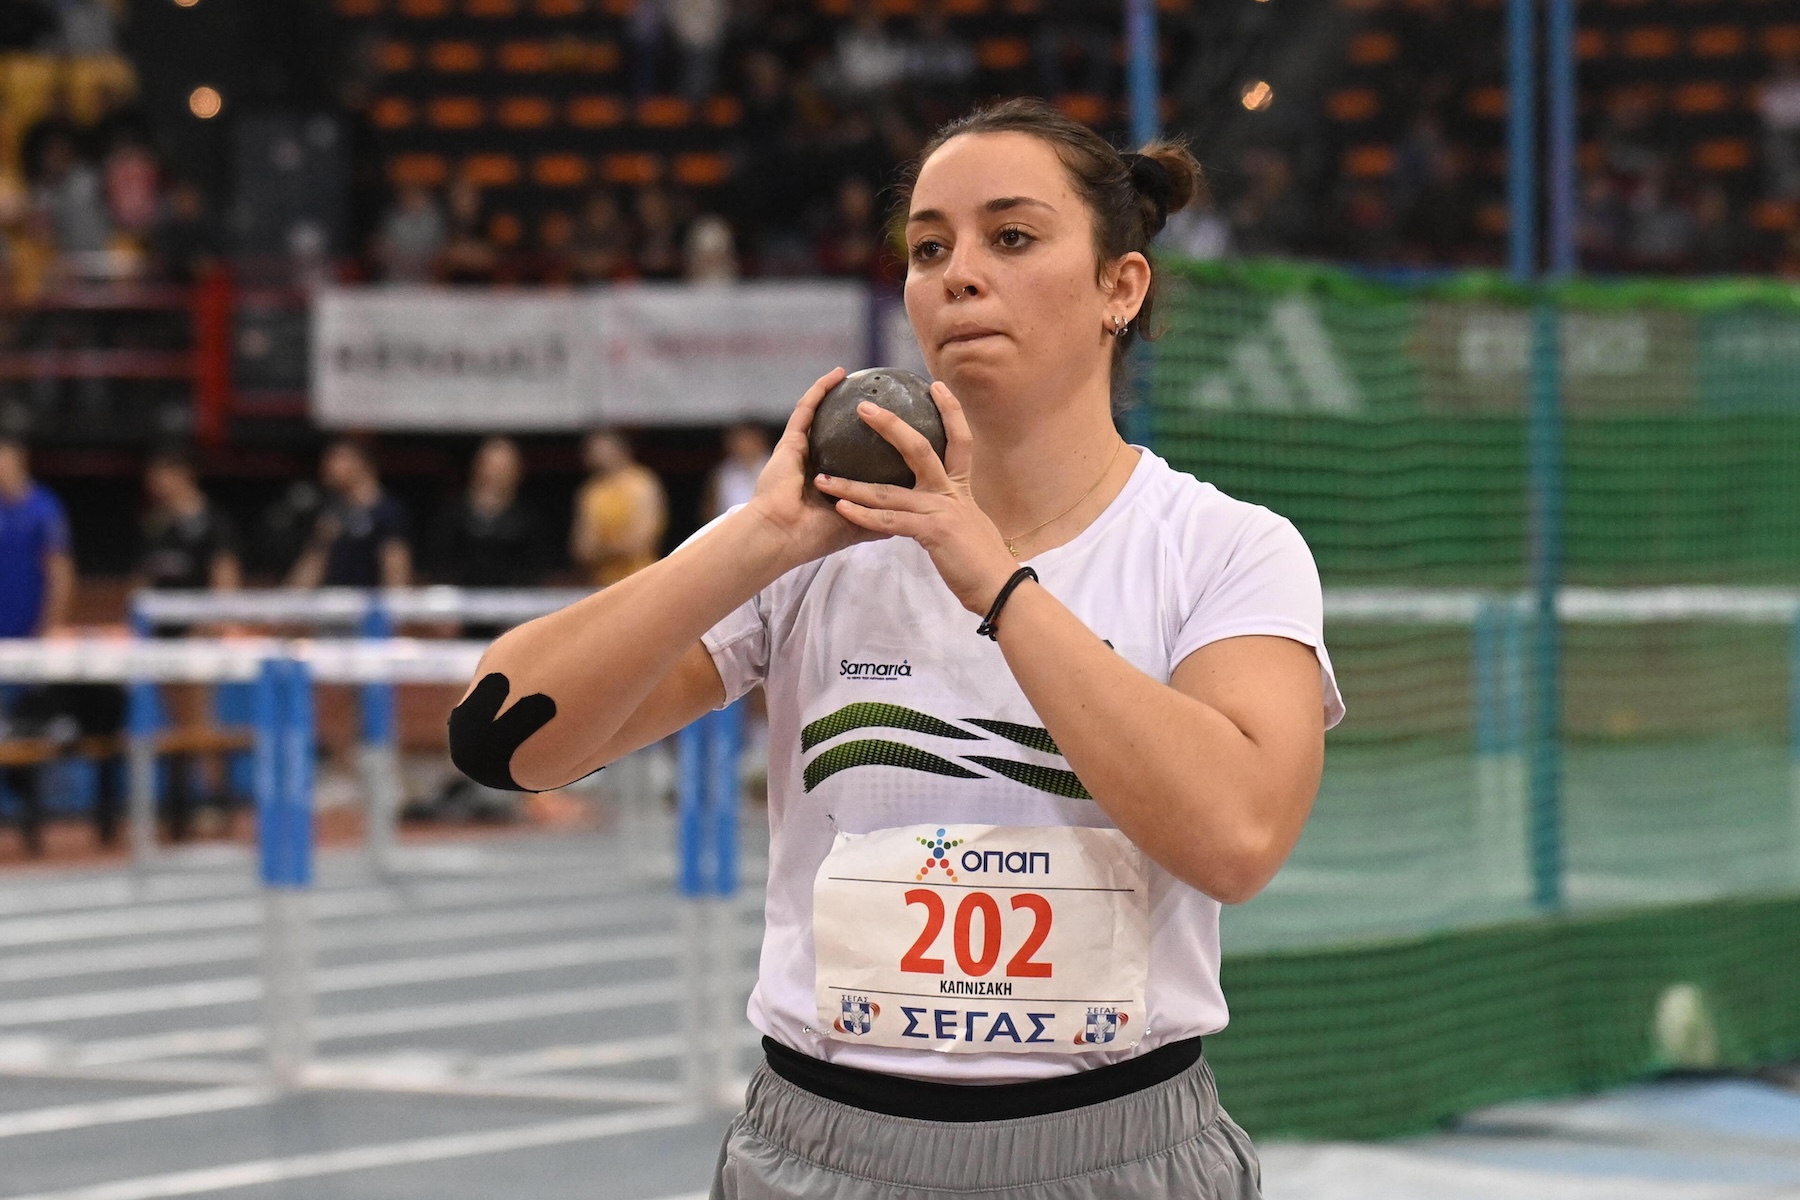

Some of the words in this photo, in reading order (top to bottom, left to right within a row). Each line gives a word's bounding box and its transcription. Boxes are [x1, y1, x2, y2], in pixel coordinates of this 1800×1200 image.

[900, 888, 1053, 978] 202
[940, 980, 1012, 996] ΚΑΠΝΙΣΑΚΗ
[841, 994, 869, 1003] ΣΕΓΑΣ
[1087, 1006, 1118, 1014] ΣΕΓΑΣ
[900, 1006, 1056, 1043] ΣΕΓΑΣ
